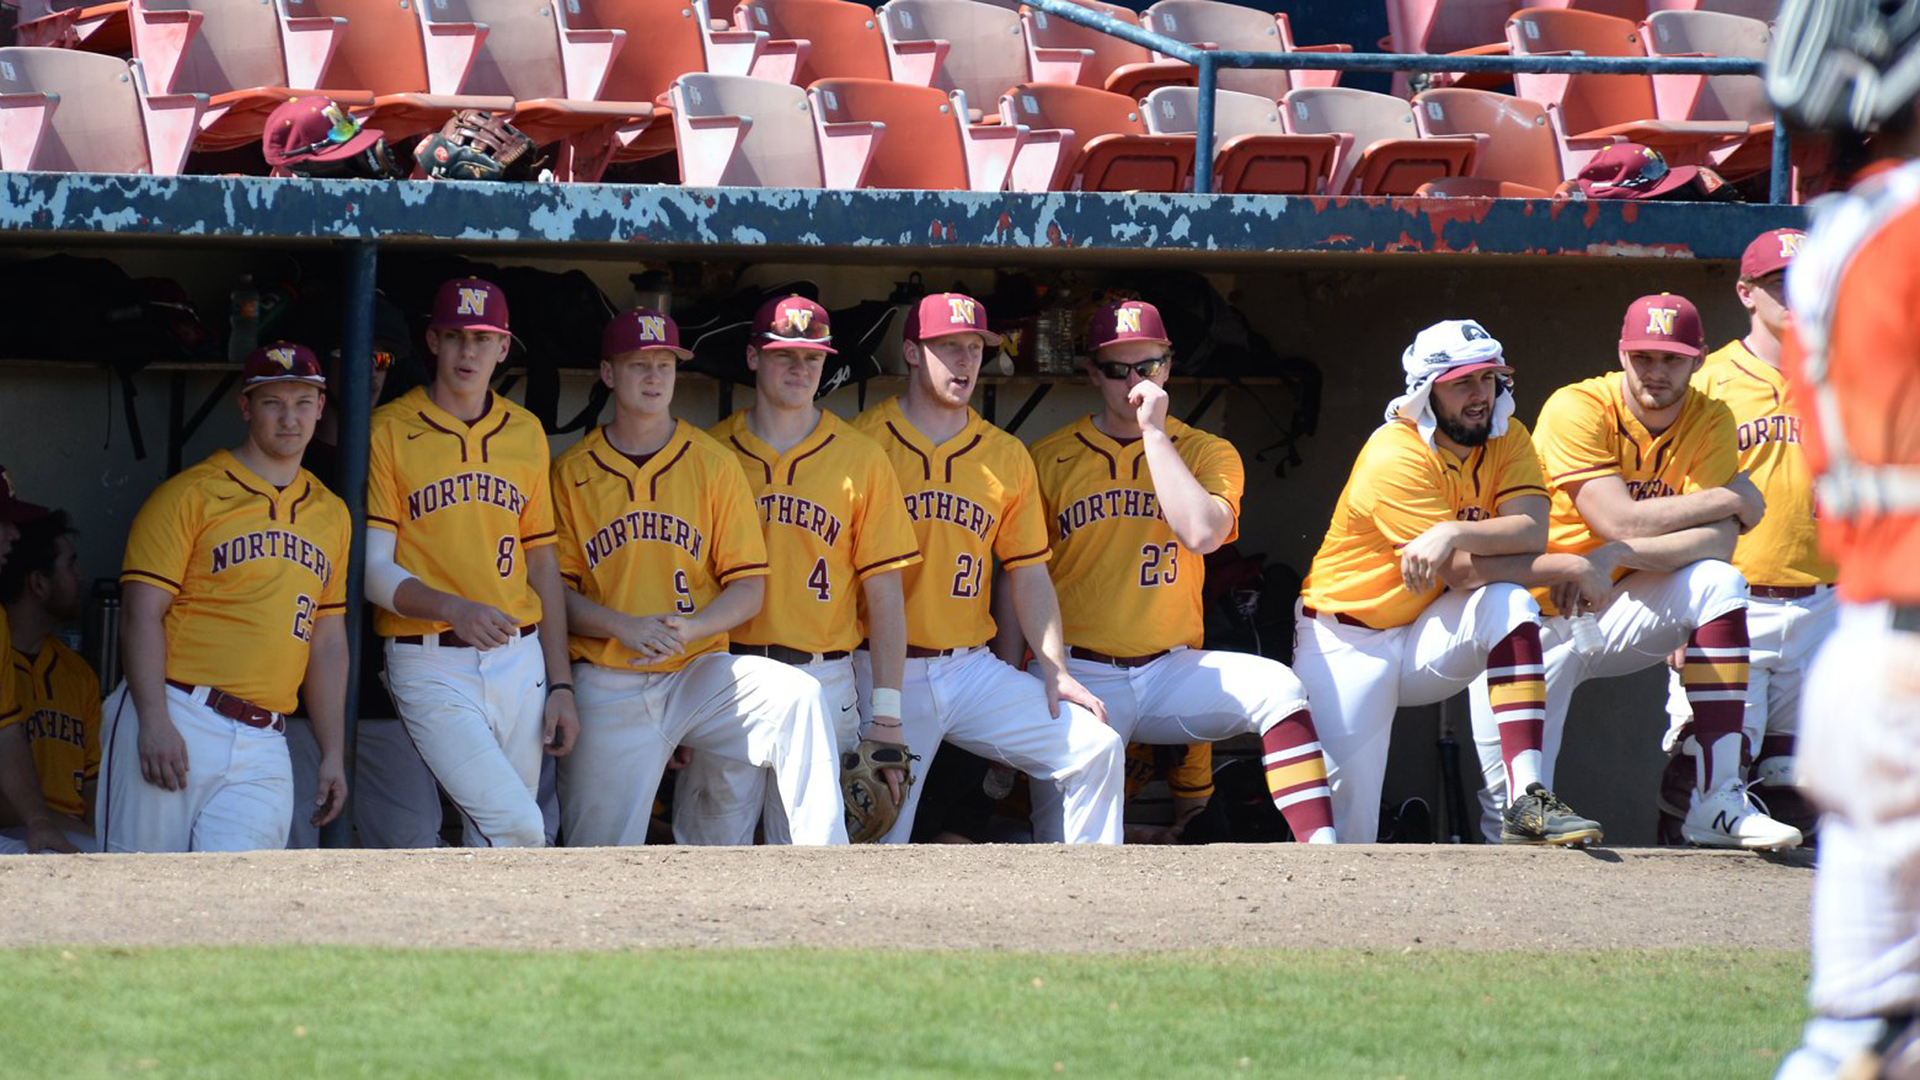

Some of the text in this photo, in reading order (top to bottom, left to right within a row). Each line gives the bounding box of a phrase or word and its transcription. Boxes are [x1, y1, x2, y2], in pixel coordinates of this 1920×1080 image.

[457, 287, 488, 316] N
[948, 298, 976, 325] N
[1114, 307, 1142, 333] N
[1646, 307, 1678, 335] N
[638, 315, 666, 342] N
[584, 510, 703, 571] NORTHERN
[755, 493, 842, 547] THERN
[496, 534, 516, 579] 8
[807, 556, 831, 601] 4
[1139, 541, 1179, 587] 23
[673, 568, 696, 615] 9
